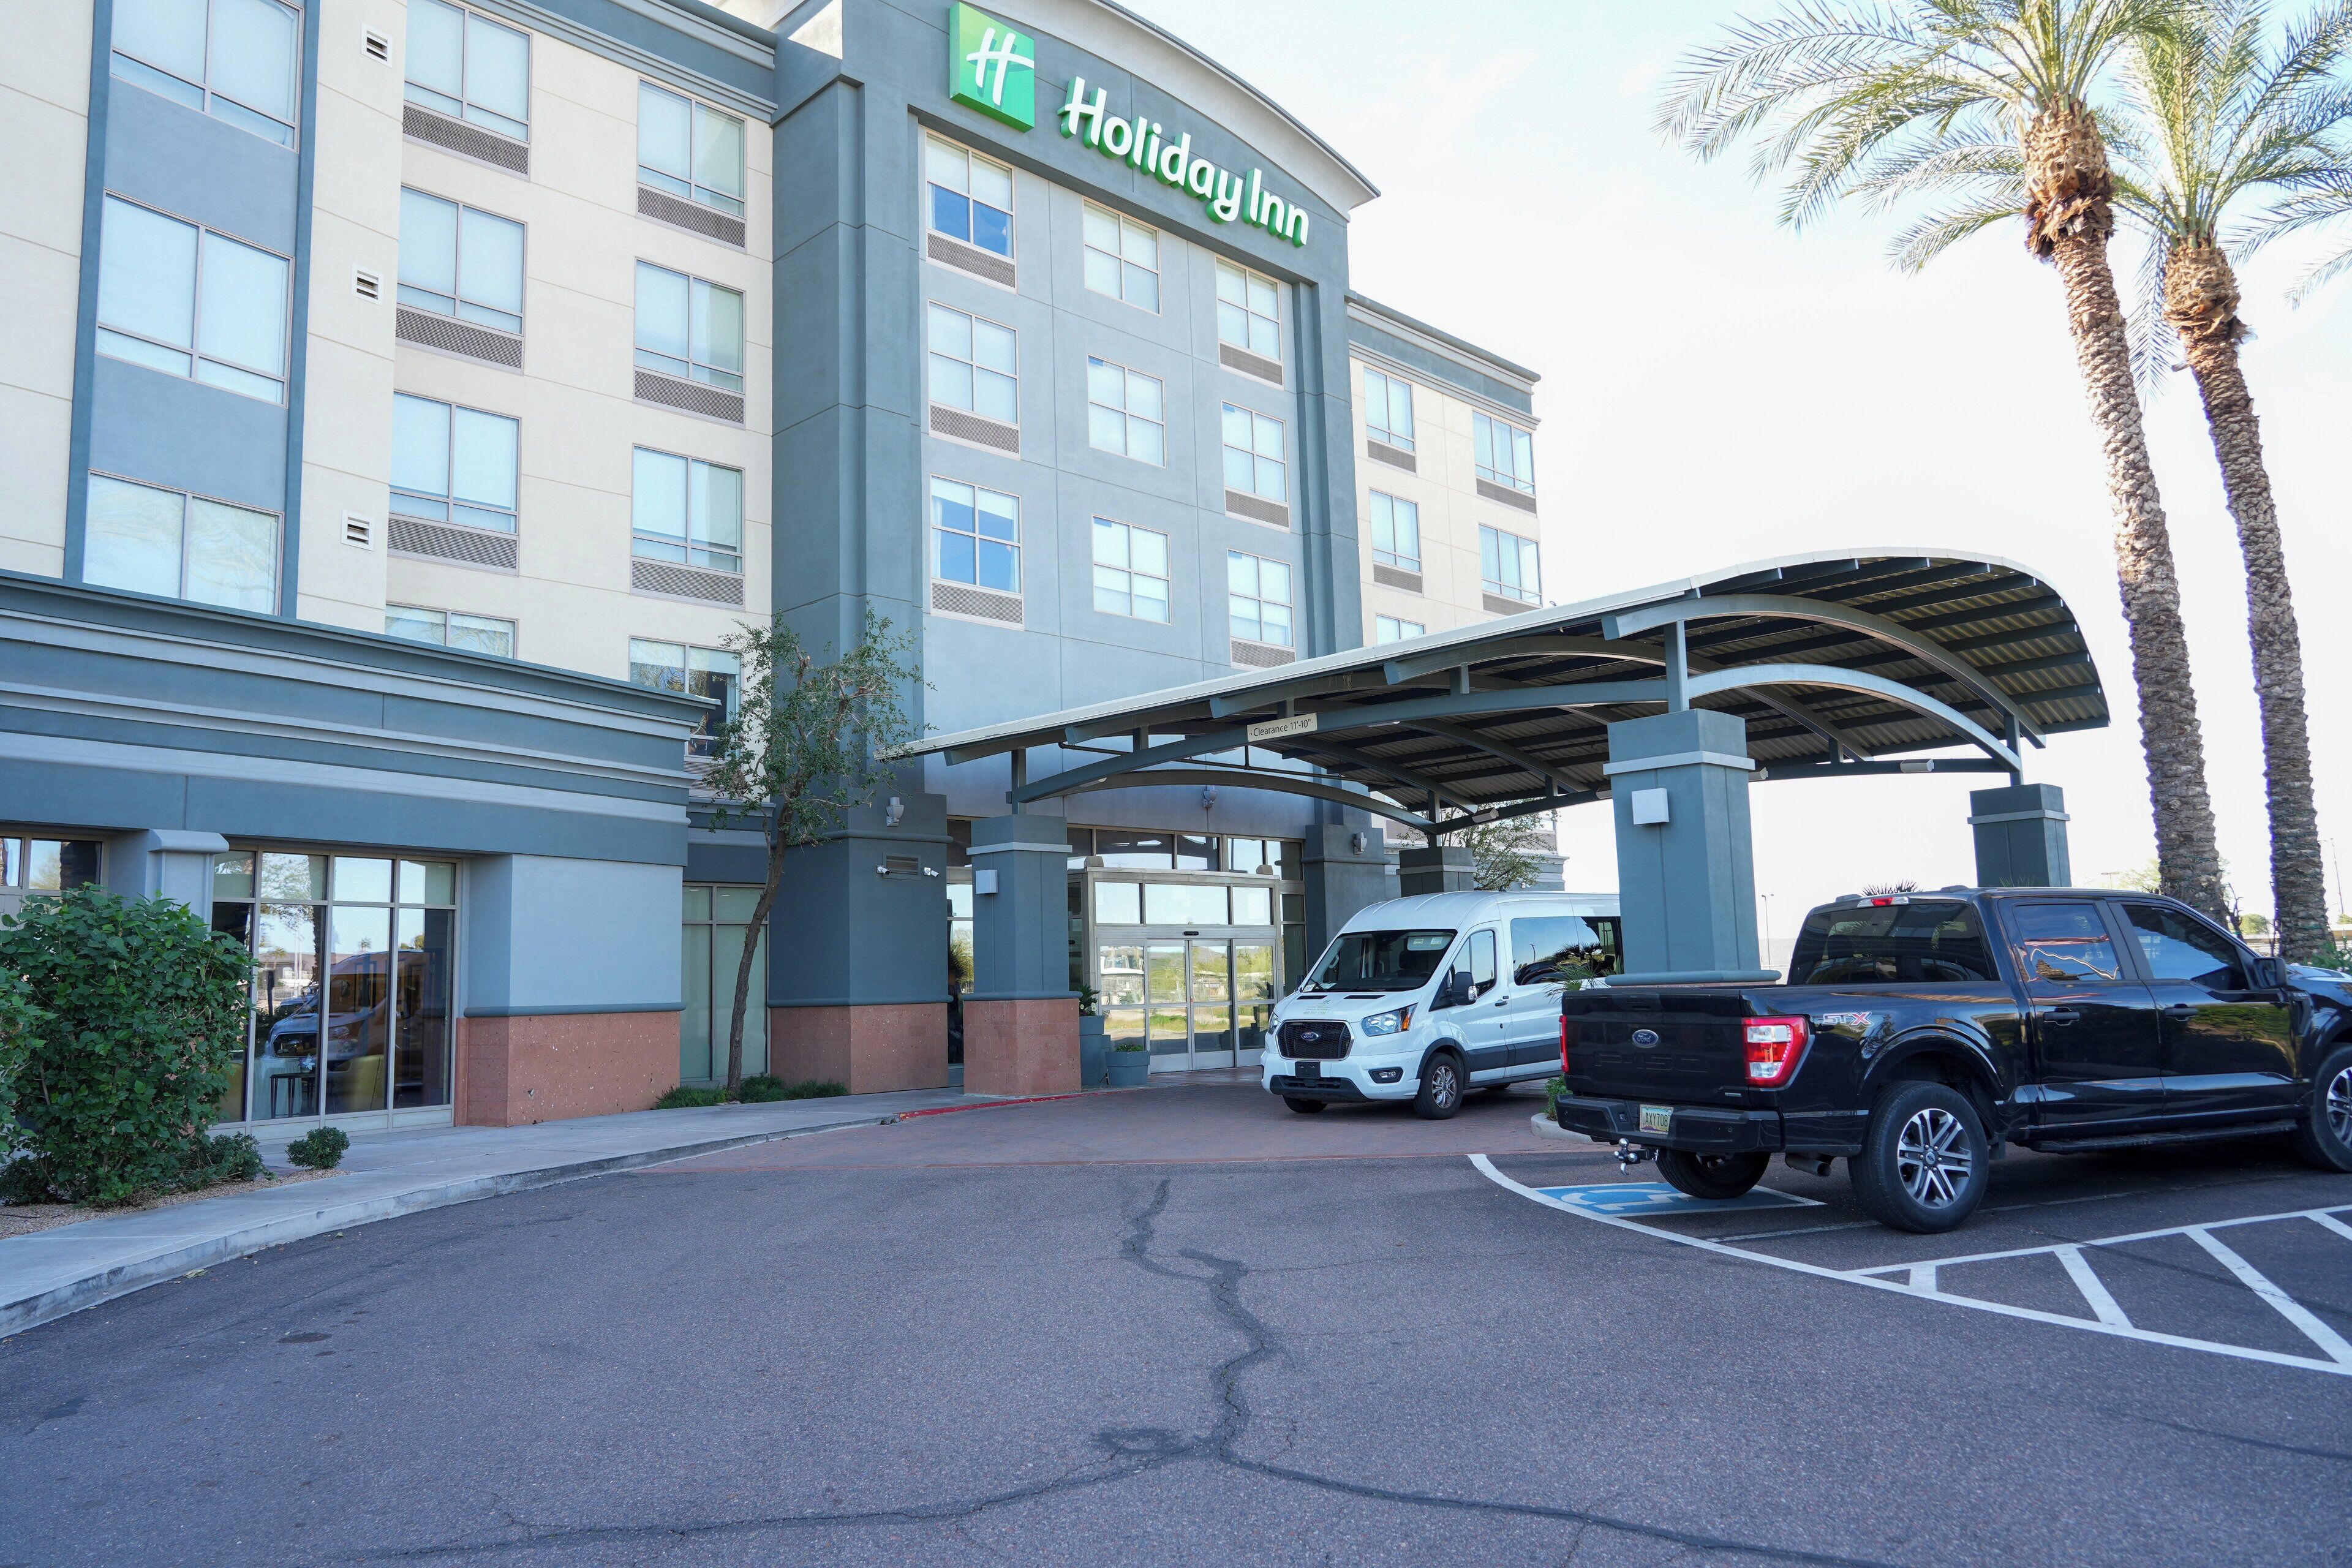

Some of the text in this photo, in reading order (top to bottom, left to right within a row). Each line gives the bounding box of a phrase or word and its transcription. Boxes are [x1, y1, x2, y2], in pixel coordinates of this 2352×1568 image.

[1059, 76, 1310, 247] Holiday Inn
[1253, 718, 1311, 736] Clearance 11'-10"
[1822, 1011, 1874, 1027] STX
[1637, 1033, 1651, 1042] Ford
[1594, 1051, 1708, 1072] F-150
[1646, 1112, 1668, 1127] AXY708
